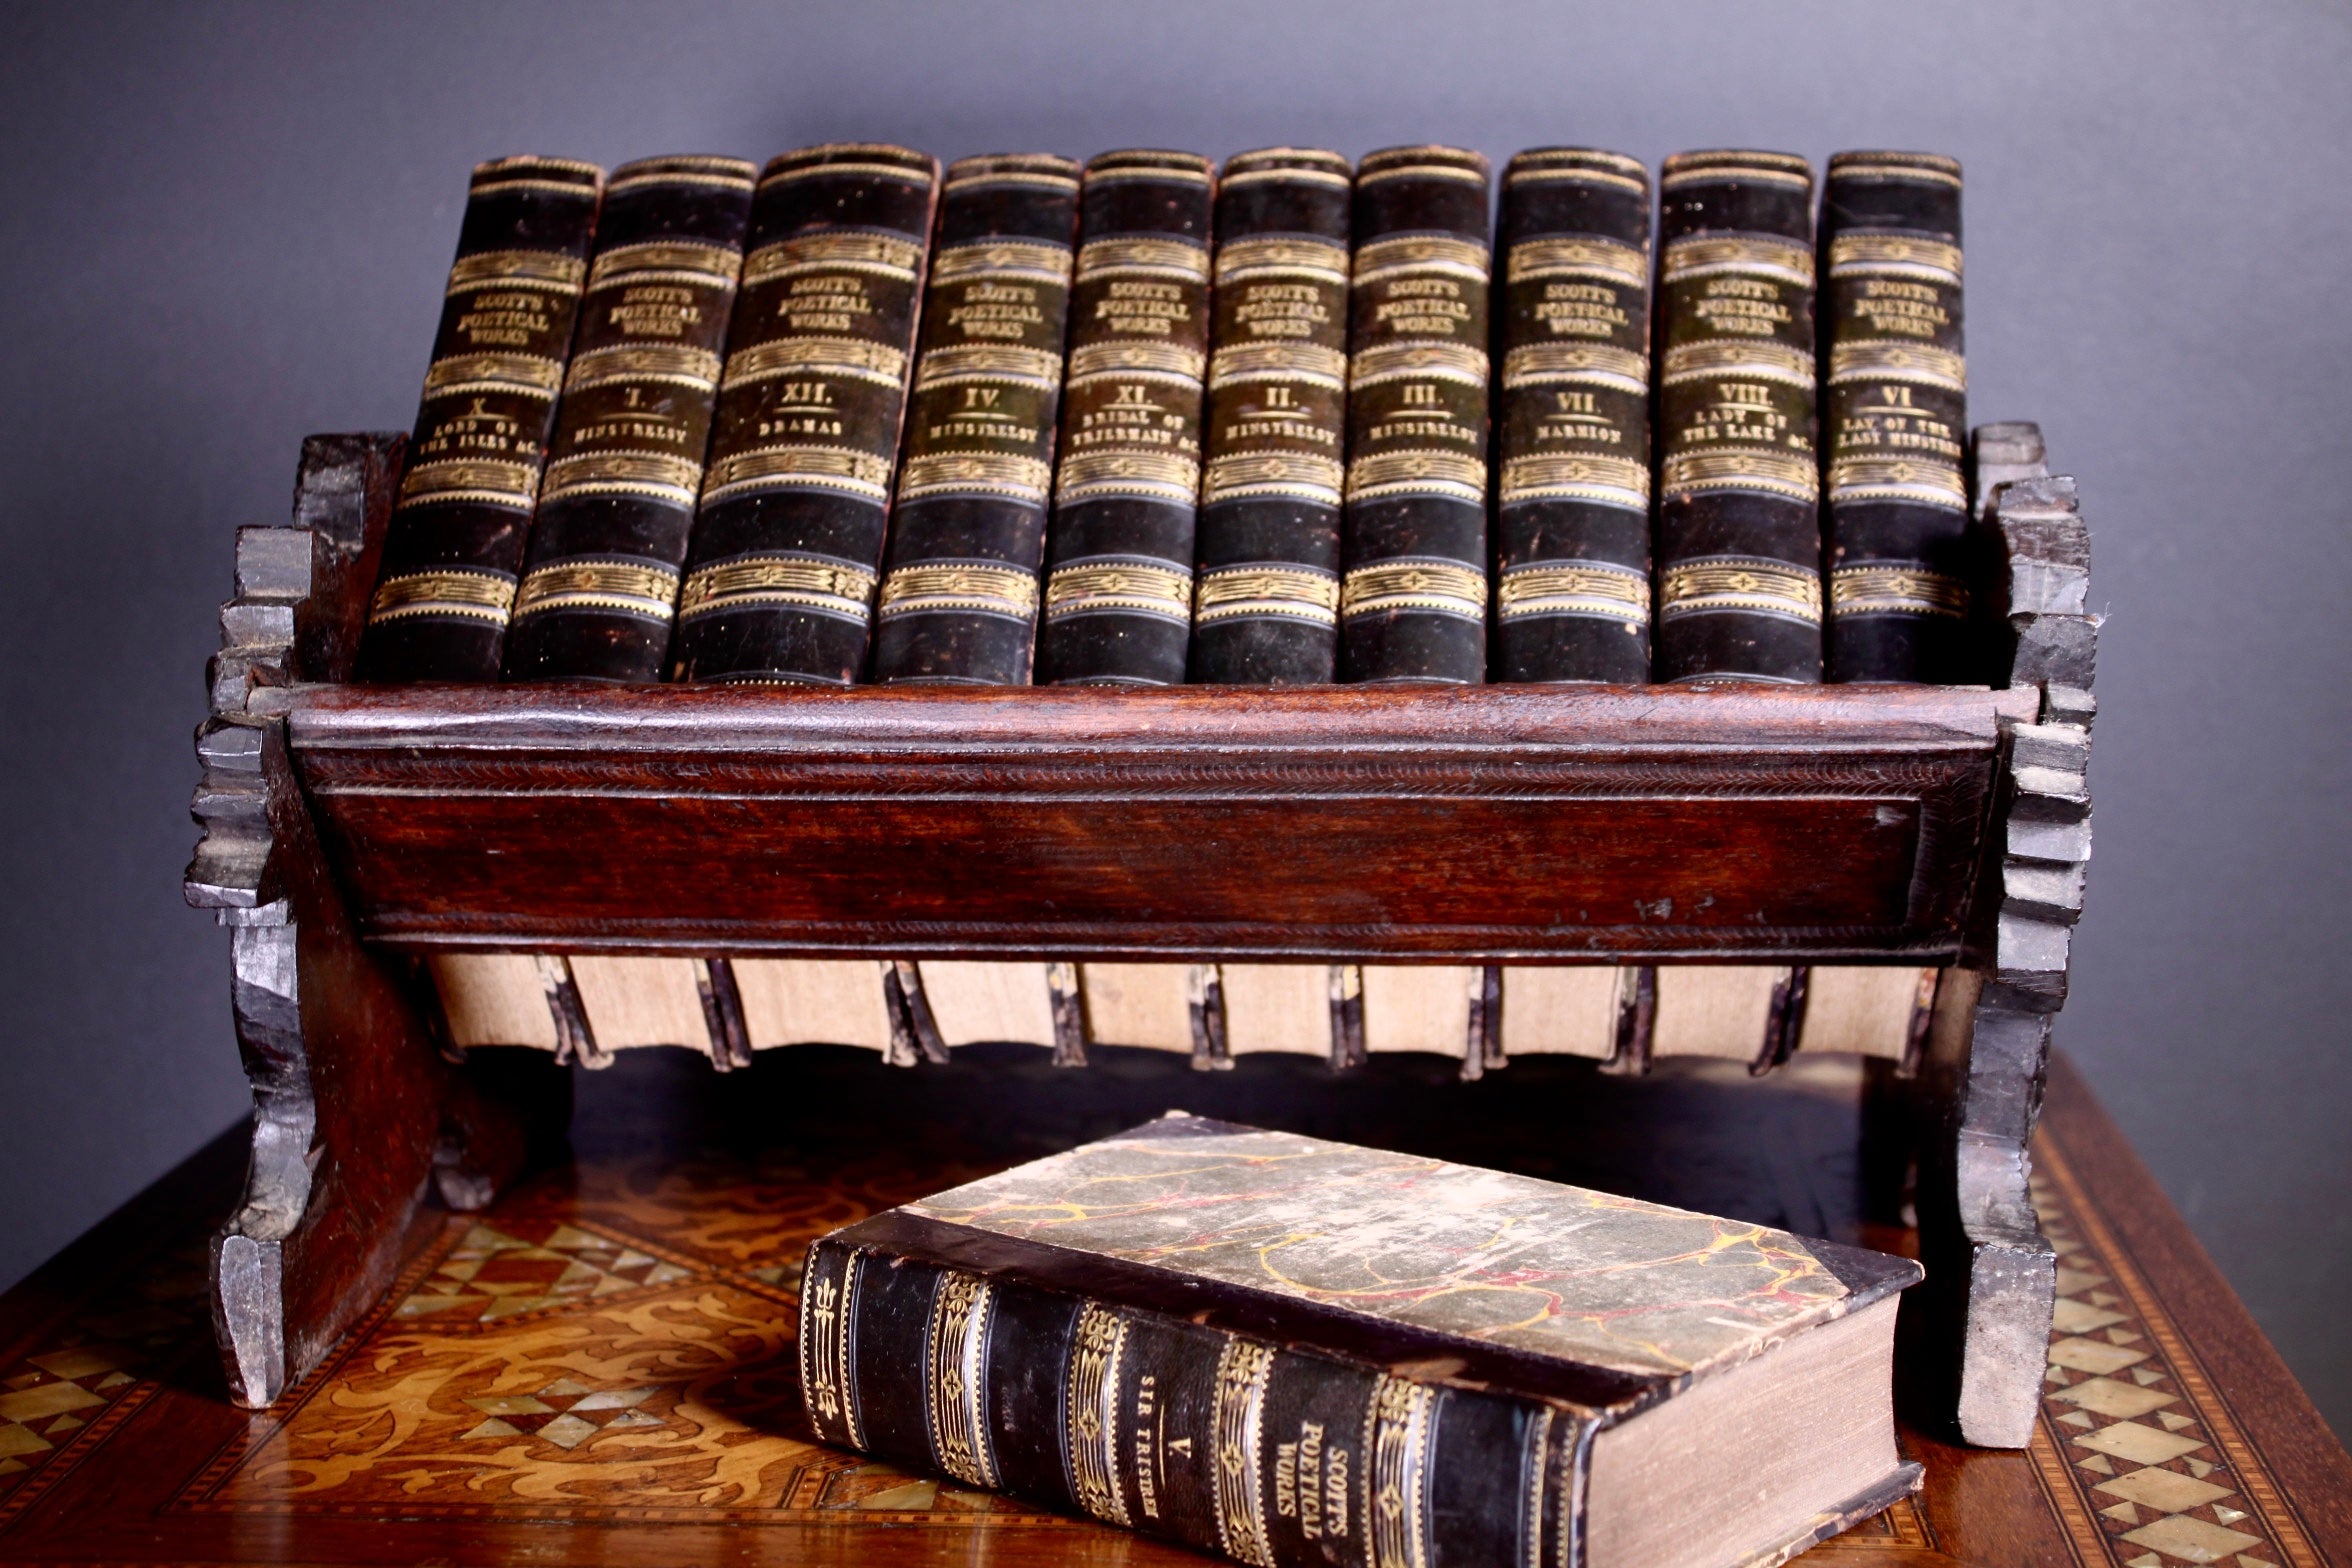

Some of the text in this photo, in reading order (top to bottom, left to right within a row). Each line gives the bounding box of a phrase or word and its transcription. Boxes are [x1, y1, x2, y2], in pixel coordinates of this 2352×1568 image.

[609, 304, 700, 324] POETICAL
[778, 296, 872, 315] POETICAL
[949, 304, 1043, 325] POETICAL
[1096, 301, 1191, 321] POETICAL
[1236, 303, 1330, 323] POETICAL
[1377, 299, 1471, 321] POETICAL
[1535, 302, 1629, 326] POETICAL
[1696, 299, 1791, 322] POETICAL
[1855, 300, 1949, 323] POETICAL
[457, 311, 549, 332] POETICAL
[624, 320, 683, 336] WORKS
[789, 313, 851, 331] WORKS
[963, 321, 1024, 339] WORKS
[1109, 317, 1171, 335] WORKS
[1249, 320, 1311, 337] WORKS
[1391, 317, 1455, 333] WORKS
[1550, 319, 1612, 337] WORKS
[1711, 316, 1774, 336] WORKS
[1872, 316, 1935, 338] WORKS
[470, 329, 529, 345] WORKS
[434, 420, 519, 438] LORD OF
[759, 419, 842, 436] DRAMAS
[1082, 410, 1184, 430] BRIDAL OF
[1695, 409, 1787, 429] LADY OF
[1843, 417, 1951, 439] LAY OF THE
[574, 422, 687, 444] MINSTRELSY
[930, 421, 1039, 443] MINSTRELSY
[1226, 422, 1336, 445] MINSTRELSY
[1369, 422, 1477, 443] MINSTRELSY
[1537, 425, 1621, 443] MARMION
[1683, 426, 1719, 442] THE
[1726, 423, 1776, 441] LAKE
[1839, 432, 1880, 448] LAST
[420, 437, 448, 455] THE
[458, 434, 507, 450] ISLES
[1136, 1376, 1155, 1416] SIR
[1276, 1442, 1297, 1517] WORKS
[1299, 1420, 1324, 1540] POETICAL
